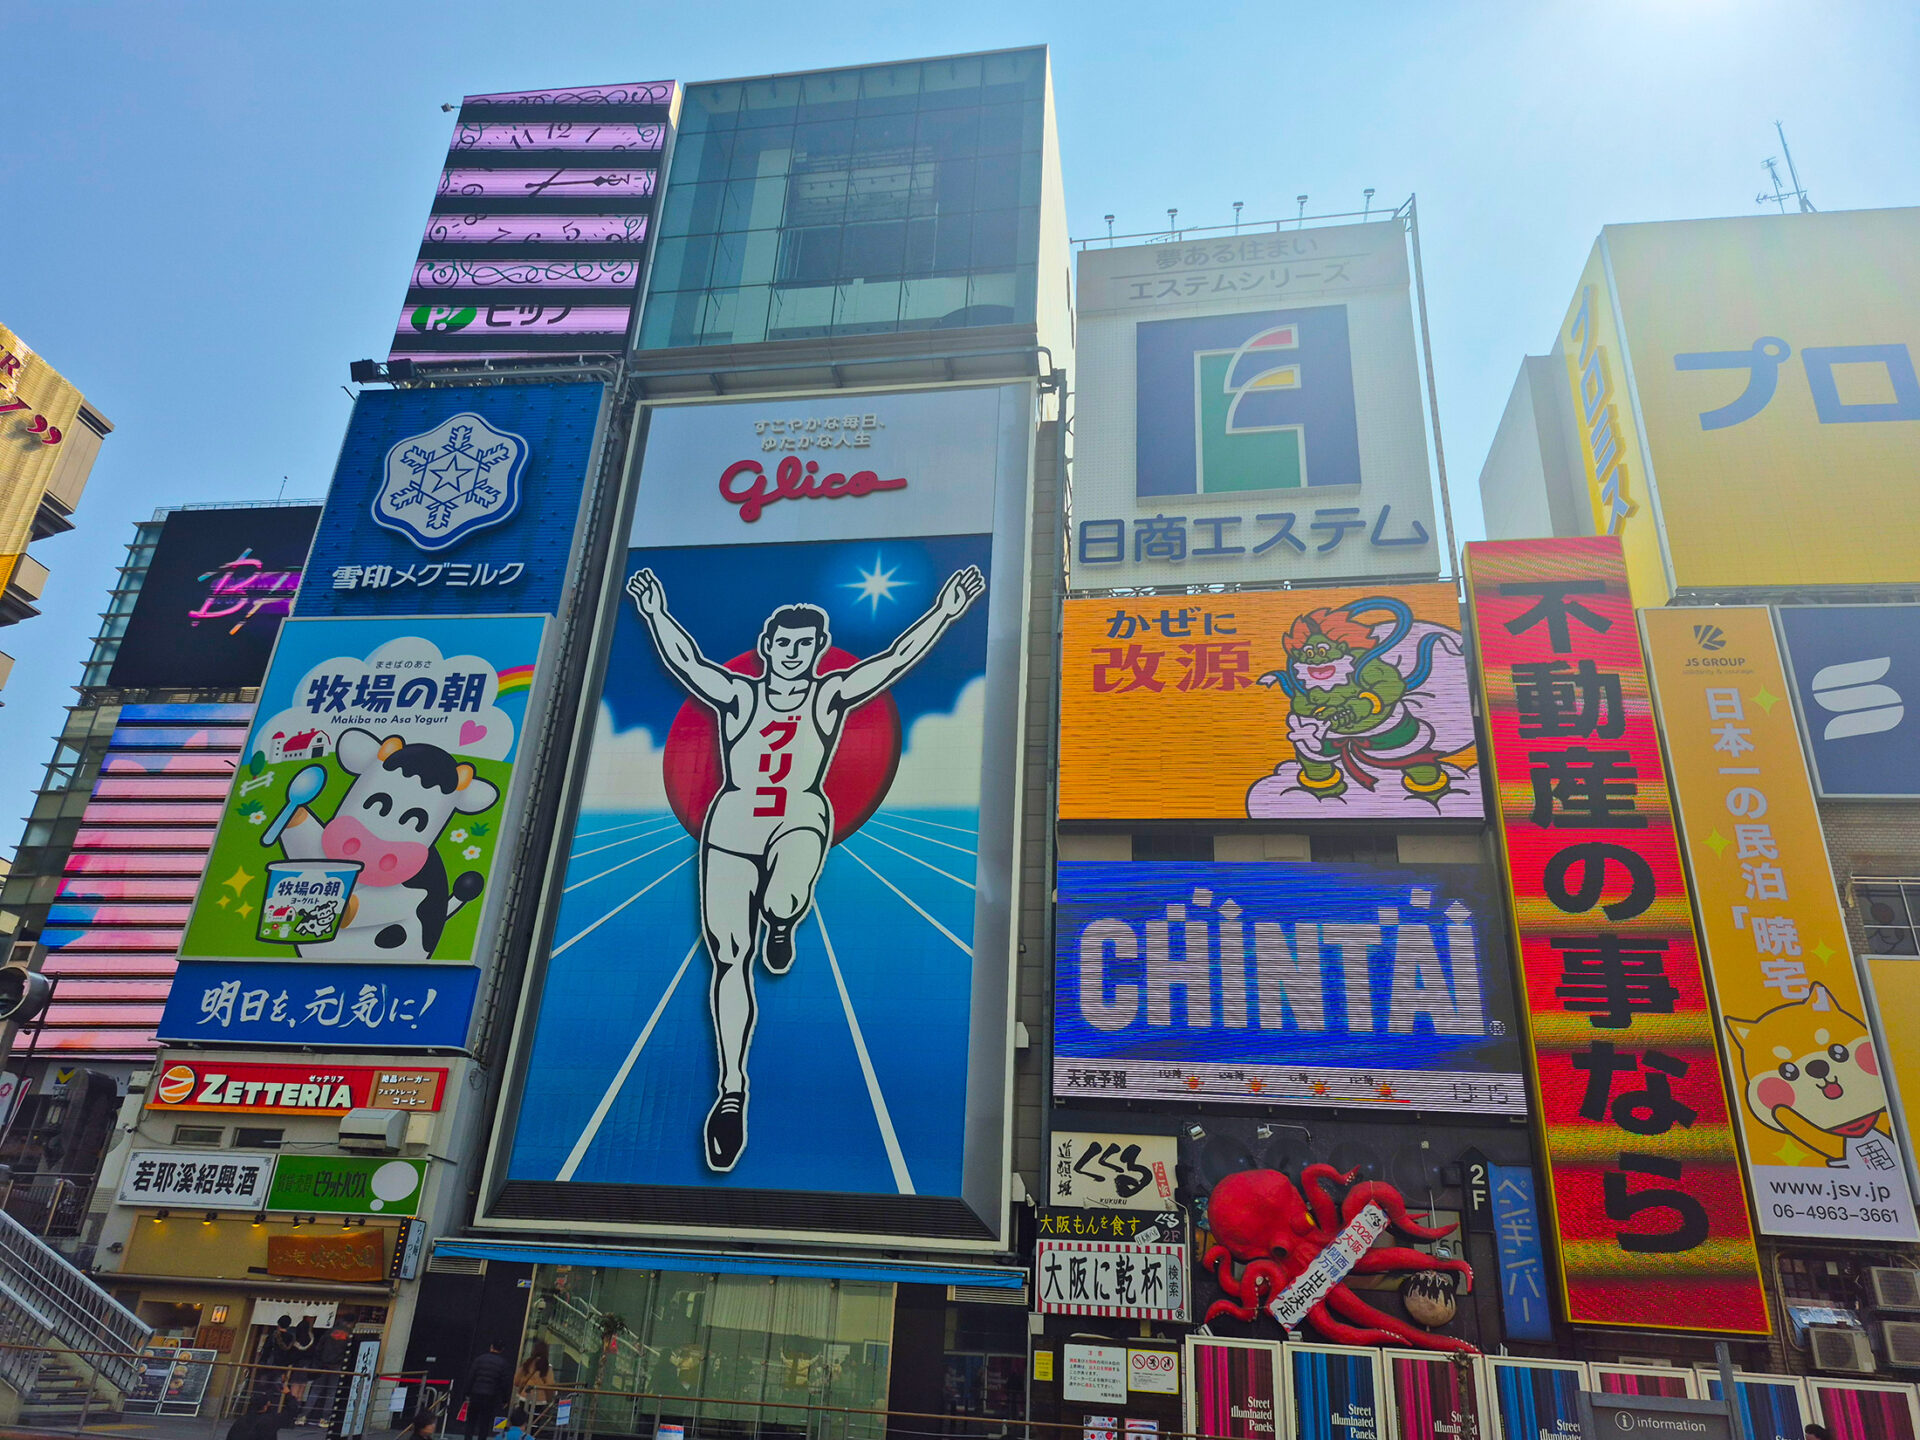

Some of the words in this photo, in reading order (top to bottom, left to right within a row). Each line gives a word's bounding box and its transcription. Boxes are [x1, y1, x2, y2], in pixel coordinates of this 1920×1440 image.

[1155, 237, 1318, 270] 夢ある住まい
[1129, 262, 1351, 300] エステムシリーズ
[761, 432, 871, 451] ゆたかな人生
[1079, 504, 1430, 564] 日商エステム
[332, 561, 525, 590] 雪印メグミルク
[1106, 606, 1237, 639] かぜに
[375, 660, 432, 670] まきばのあさ
[1090, 640, 1257, 694] 改源
[1684, 658, 1700, 667] JS
[1702, 657, 1746, 667] GROUP
[307, 672, 488, 714] 牧場の朝
[331, 715, 371, 725] Makiba
[374, 717, 388, 725] no
[390, 716, 411, 724] Asa
[414, 714, 449, 726] Yogurt
[753, 715, 802, 818] グリコ
[278, 880, 342, 897] 牧場の朝
[1498, 579, 1709, 1254] 不動産の事なら
[1079, 888, 1486, 1036] CHINTAI
[197, 1073, 352, 1108] ZETTERIA
[308, 1074, 345, 1083] ゼッテリア
[1066, 1069, 1127, 1090] 天気予報
[392, 1097, 426, 1106] コーヒー
[1073, 1141, 1153, 1198] くくる
[1470, 1164, 1486, 1210] 2F
[1770, 1180, 1891, 1202] www.jsv.jp
[1154, 1213, 1180, 1229] くくる
[1773, 1203, 1899, 1223] 06-4963-3661
[1040, 1214, 1141, 1237] 大阪もんを食す
[1163, 1230, 1181, 1243] 2F
[1352, 1221, 1374, 1245] 2025
[1497, 1179, 1541, 1323] ペンギンバー
[1044, 1253, 1163, 1306] 大阪に乾杯
[1168, 1264, 1179, 1297] 検索
[1277, 1270, 1327, 1320] 出店決定
[1247, 1395, 1270, 1409] Street
[1348, 1403, 1372, 1417] Street
[1636, 1416, 1706, 1433] information
